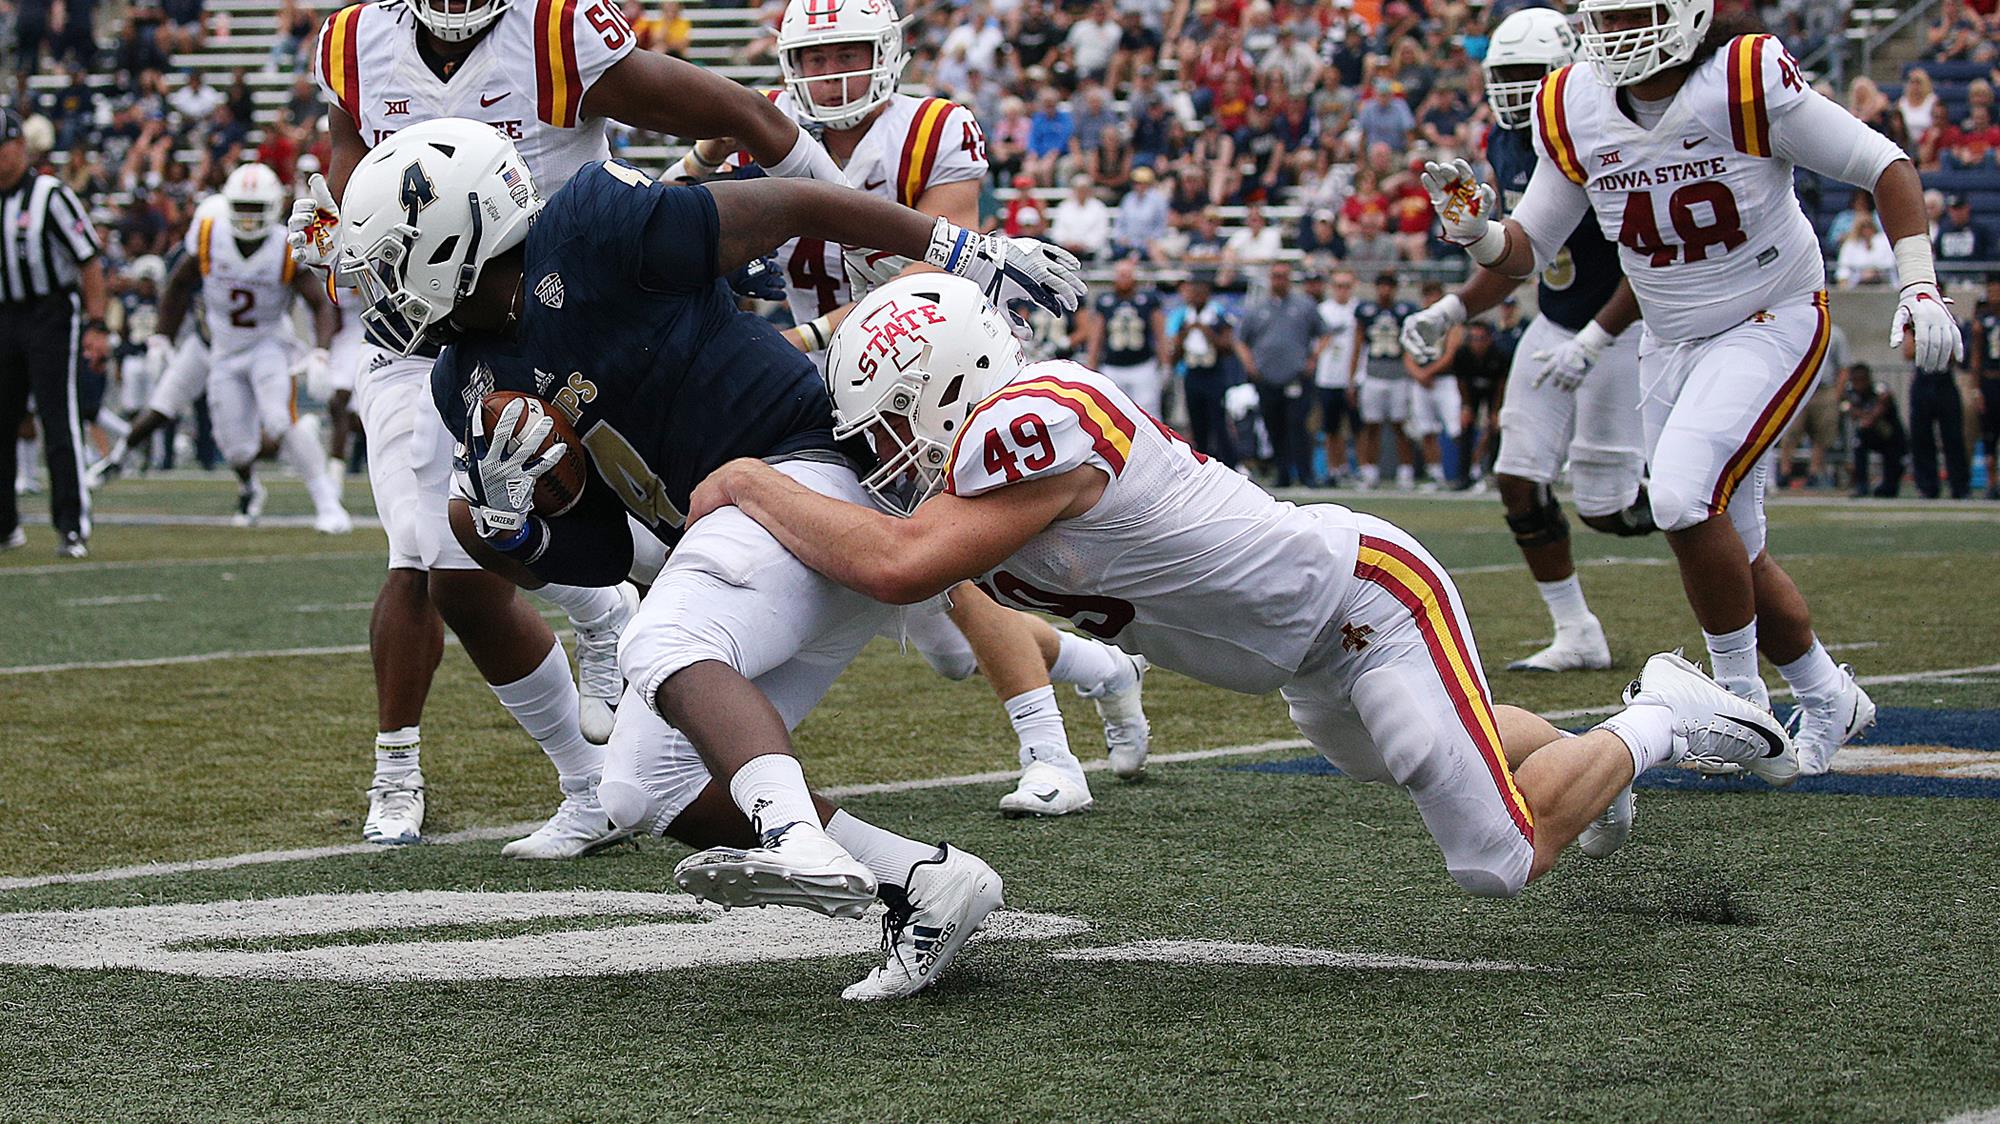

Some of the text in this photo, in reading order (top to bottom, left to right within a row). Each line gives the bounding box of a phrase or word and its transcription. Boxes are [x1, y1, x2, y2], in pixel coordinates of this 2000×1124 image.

[384, 100, 410, 116] XII
[1598, 150, 1622, 167] XII
[1600, 157, 1727, 191] IOWA STATE
[1618, 181, 1748, 268] 48
[231, 289, 257, 328] 2
[539, 278, 565, 304] MAC
[858, 304, 947, 382] STATE
[538, 372, 555, 396] adidas
[983, 413, 1056, 483] 49
[581, 419, 687, 529] 4
[919, 921, 956, 976] adidas
